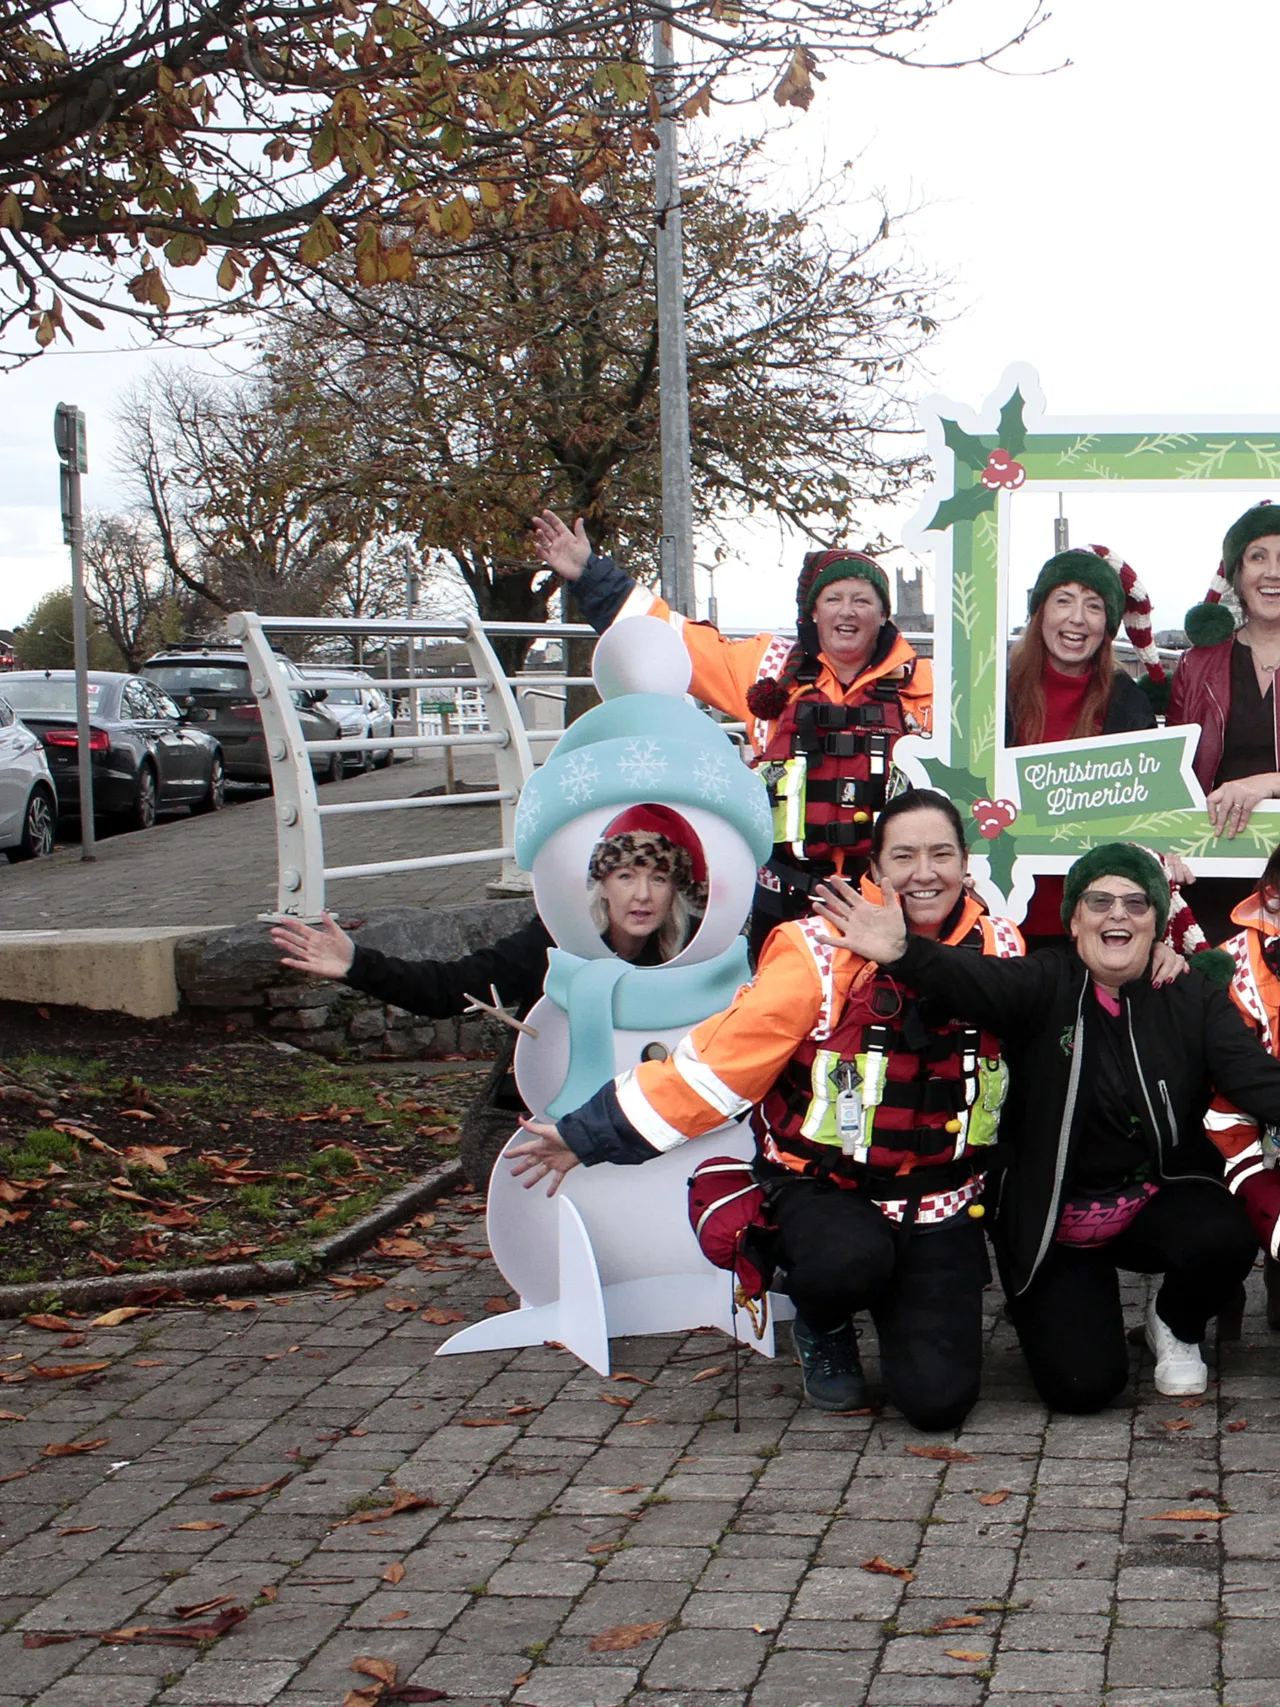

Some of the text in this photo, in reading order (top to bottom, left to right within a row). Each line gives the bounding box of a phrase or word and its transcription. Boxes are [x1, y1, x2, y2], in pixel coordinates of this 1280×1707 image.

[1024, 752, 1161, 791] Christmas in
[1046, 776, 1149, 816] Limerick
